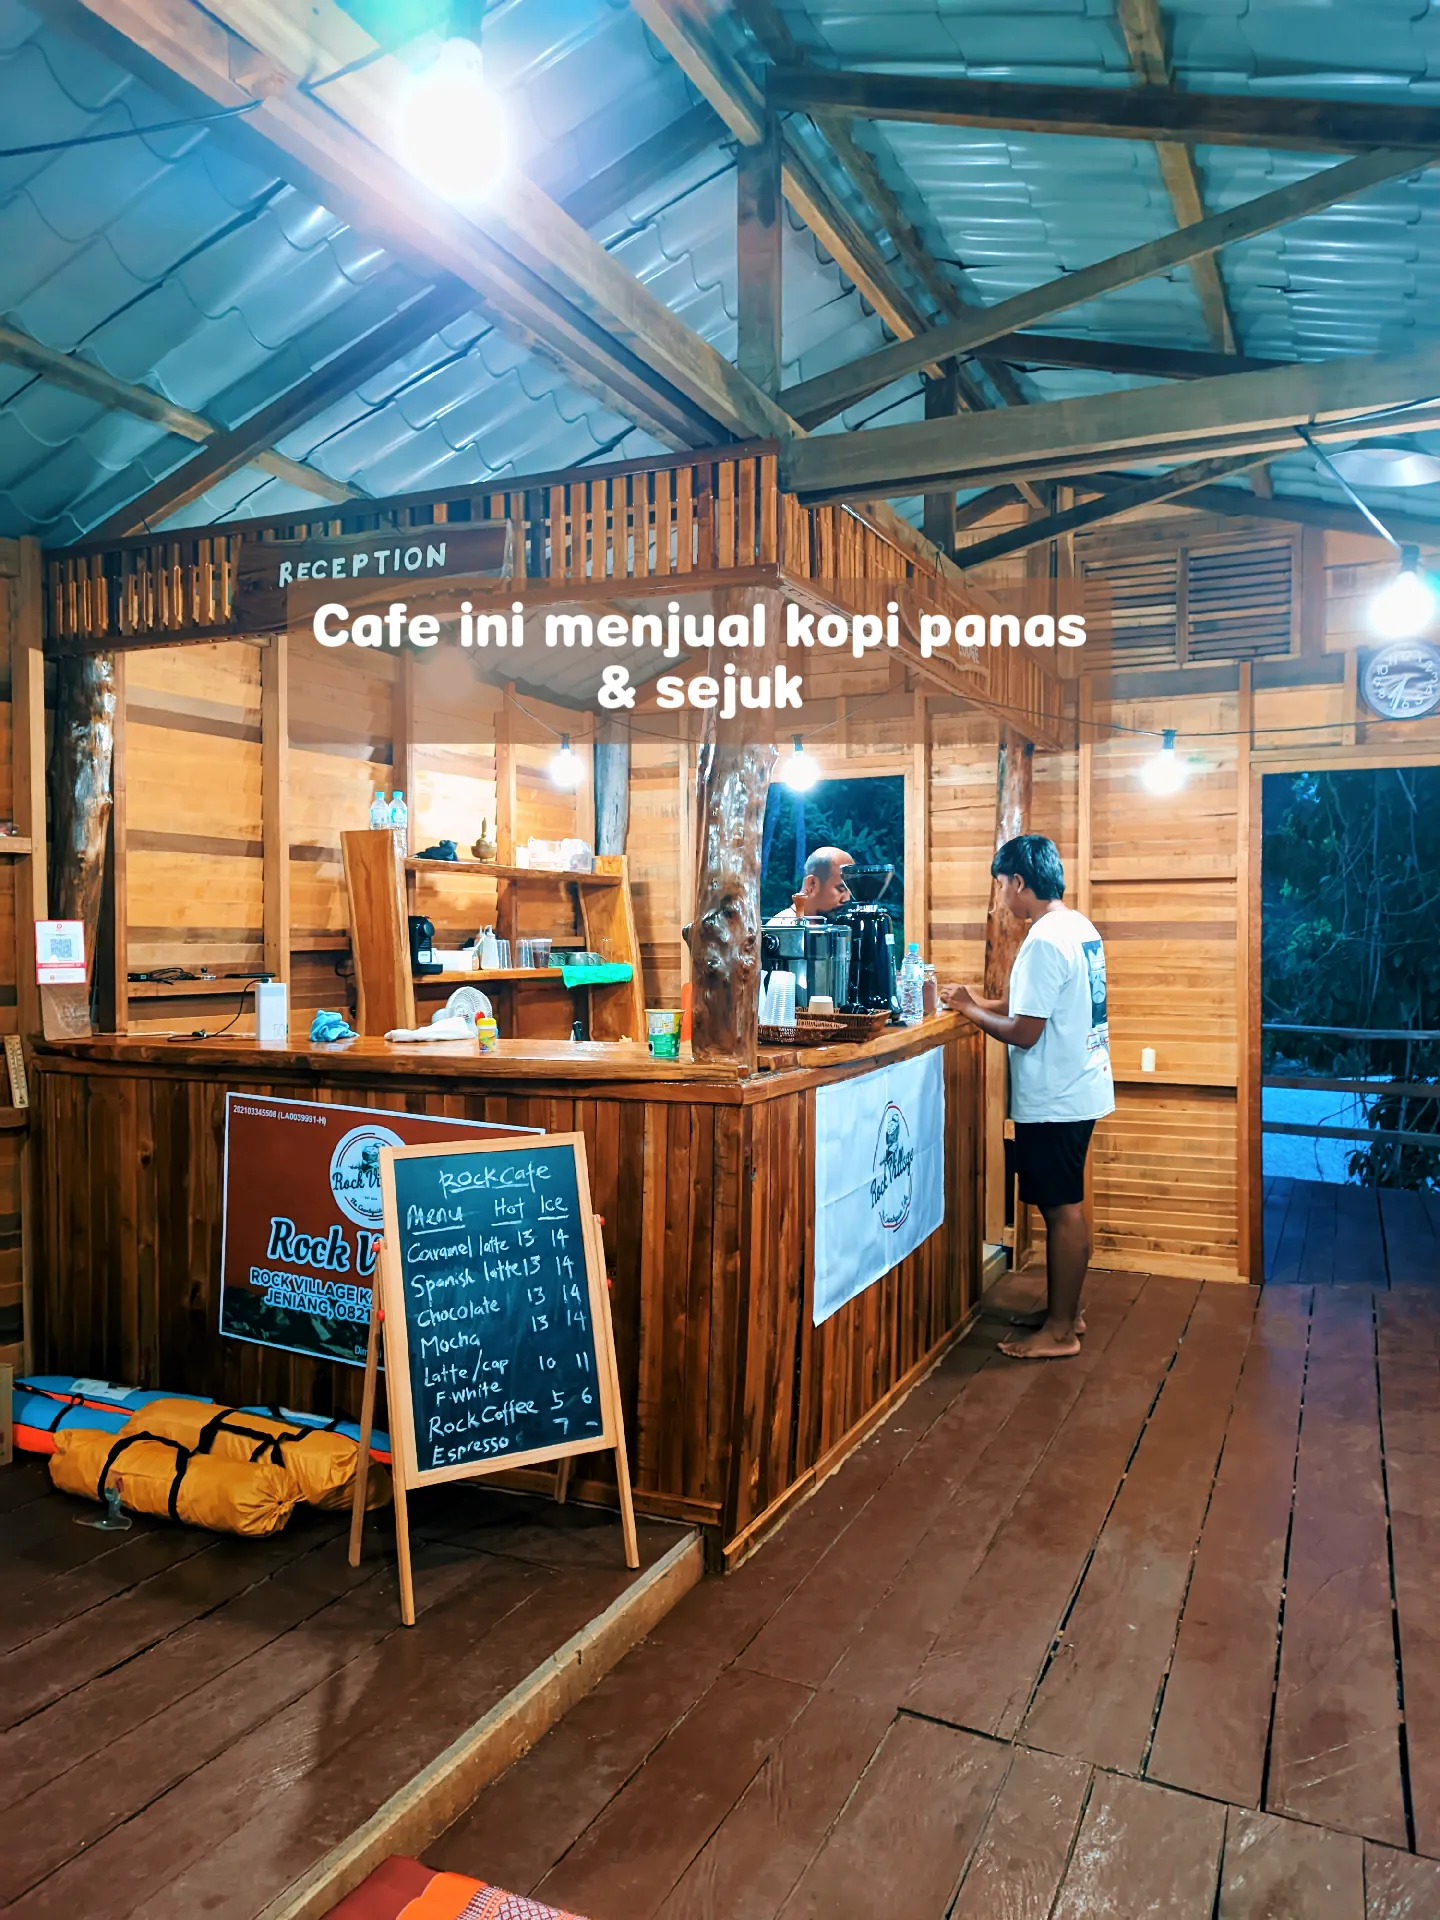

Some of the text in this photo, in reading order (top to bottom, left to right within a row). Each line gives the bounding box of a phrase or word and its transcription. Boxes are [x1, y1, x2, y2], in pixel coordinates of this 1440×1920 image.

[279, 542, 447, 588] RECEPTION
[1377, 664, 1388, 675] 10
[1425, 660, 1434, 672] 2
[1431, 671, 1439, 683] 3
[1402, 698, 1410, 709] 6
[1425, 684, 1433, 694] 4
[332, 1169, 365, 1191] Rock
[407, 1195, 569, 1230] Menu Hot Ice
[267, 1217, 351, 1273] Rock
[407, 1228, 569, 1263] Caramel latte 13 14
[250, 1267, 372, 1305] ROCK VILLAGE K
[411, 1255, 574, 1306] Spanish latte 13 14
[264, 1287, 372, 1325] JENIANG, 0821
[417, 1283, 582, 1327] Chocolate 13 14
[420, 1309, 586, 1359] Mocha 13 14
[539, 1355, 557, 1371] 10
[575, 1351, 589, 1372] 11
[428, 1386, 593, 1442] Rock Coffee 5 6
[432, 1436, 510, 1466] Espresso
[552, 1417, 569, 1435] 7
